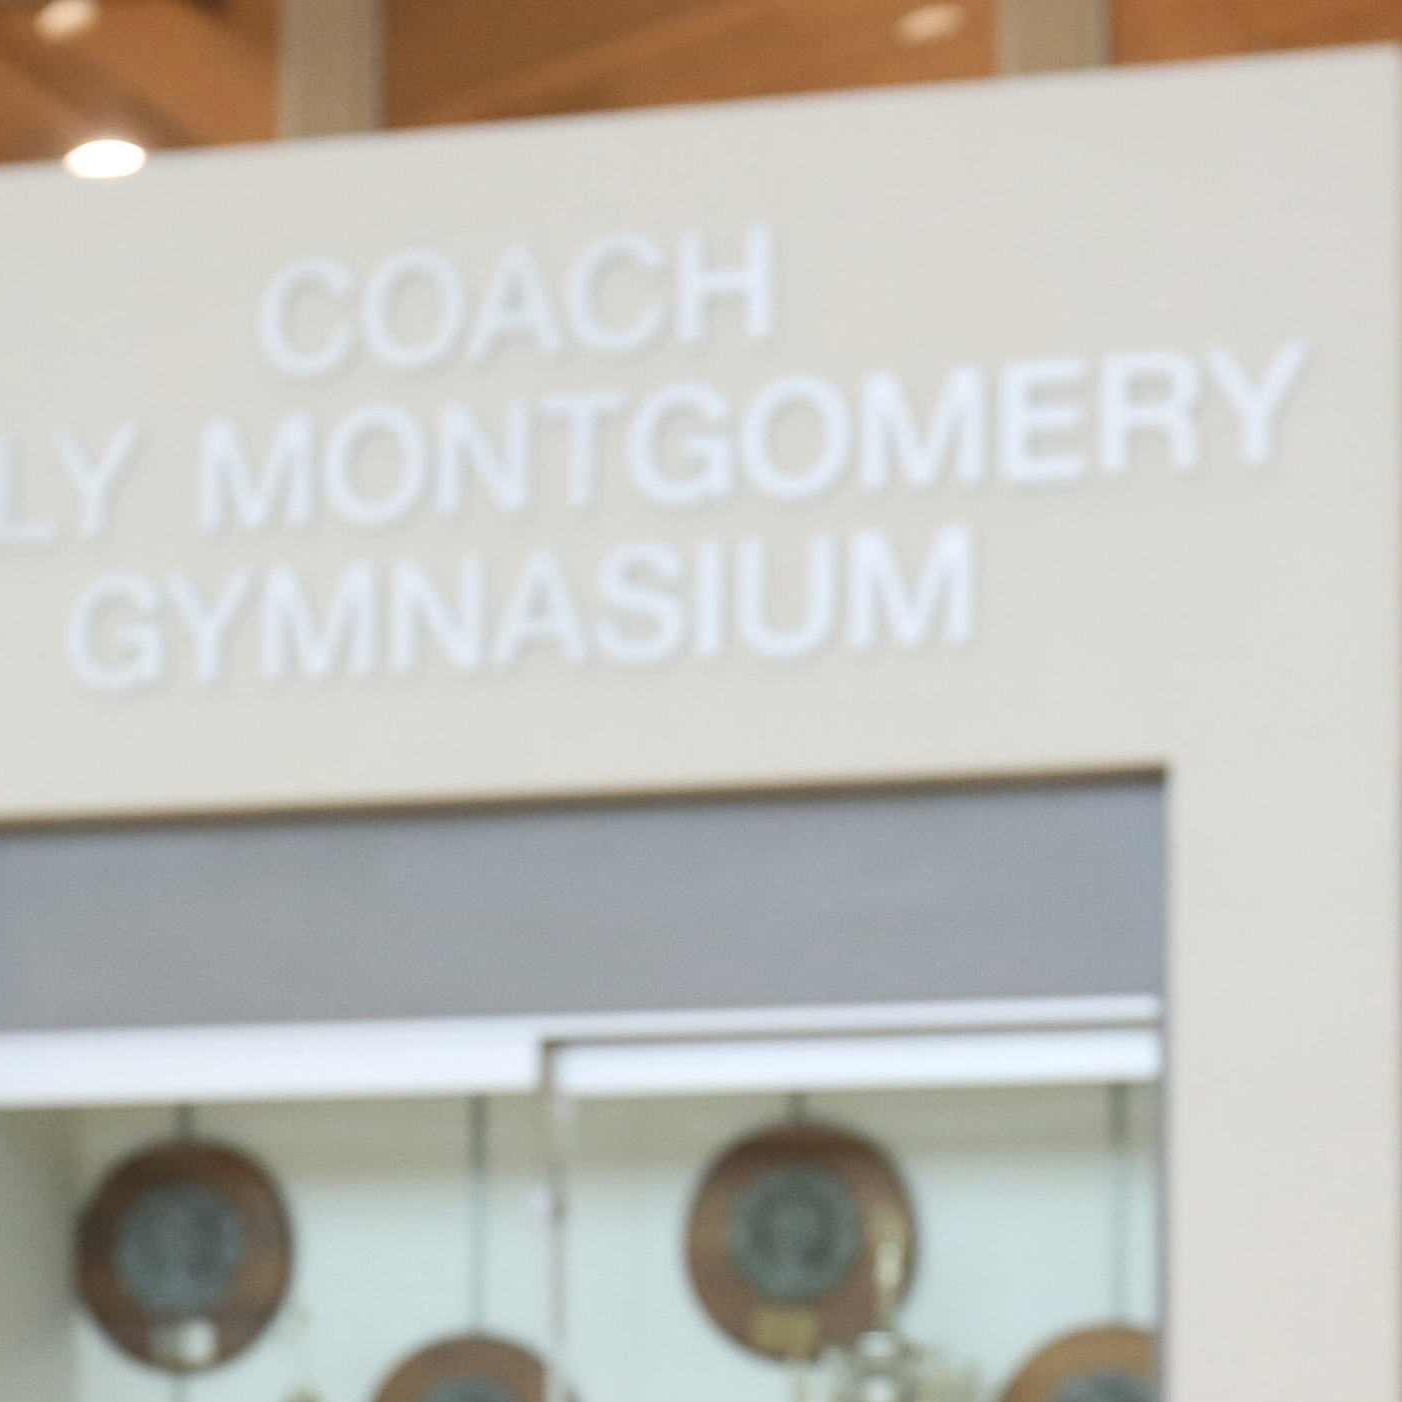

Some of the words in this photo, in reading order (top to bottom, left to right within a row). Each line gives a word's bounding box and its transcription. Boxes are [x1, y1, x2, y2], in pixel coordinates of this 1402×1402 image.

[256, 224, 776, 376] COACH
[196, 342, 1311, 534] MONTGOMERY
[64, 526, 978, 692] GYMNASIUM
